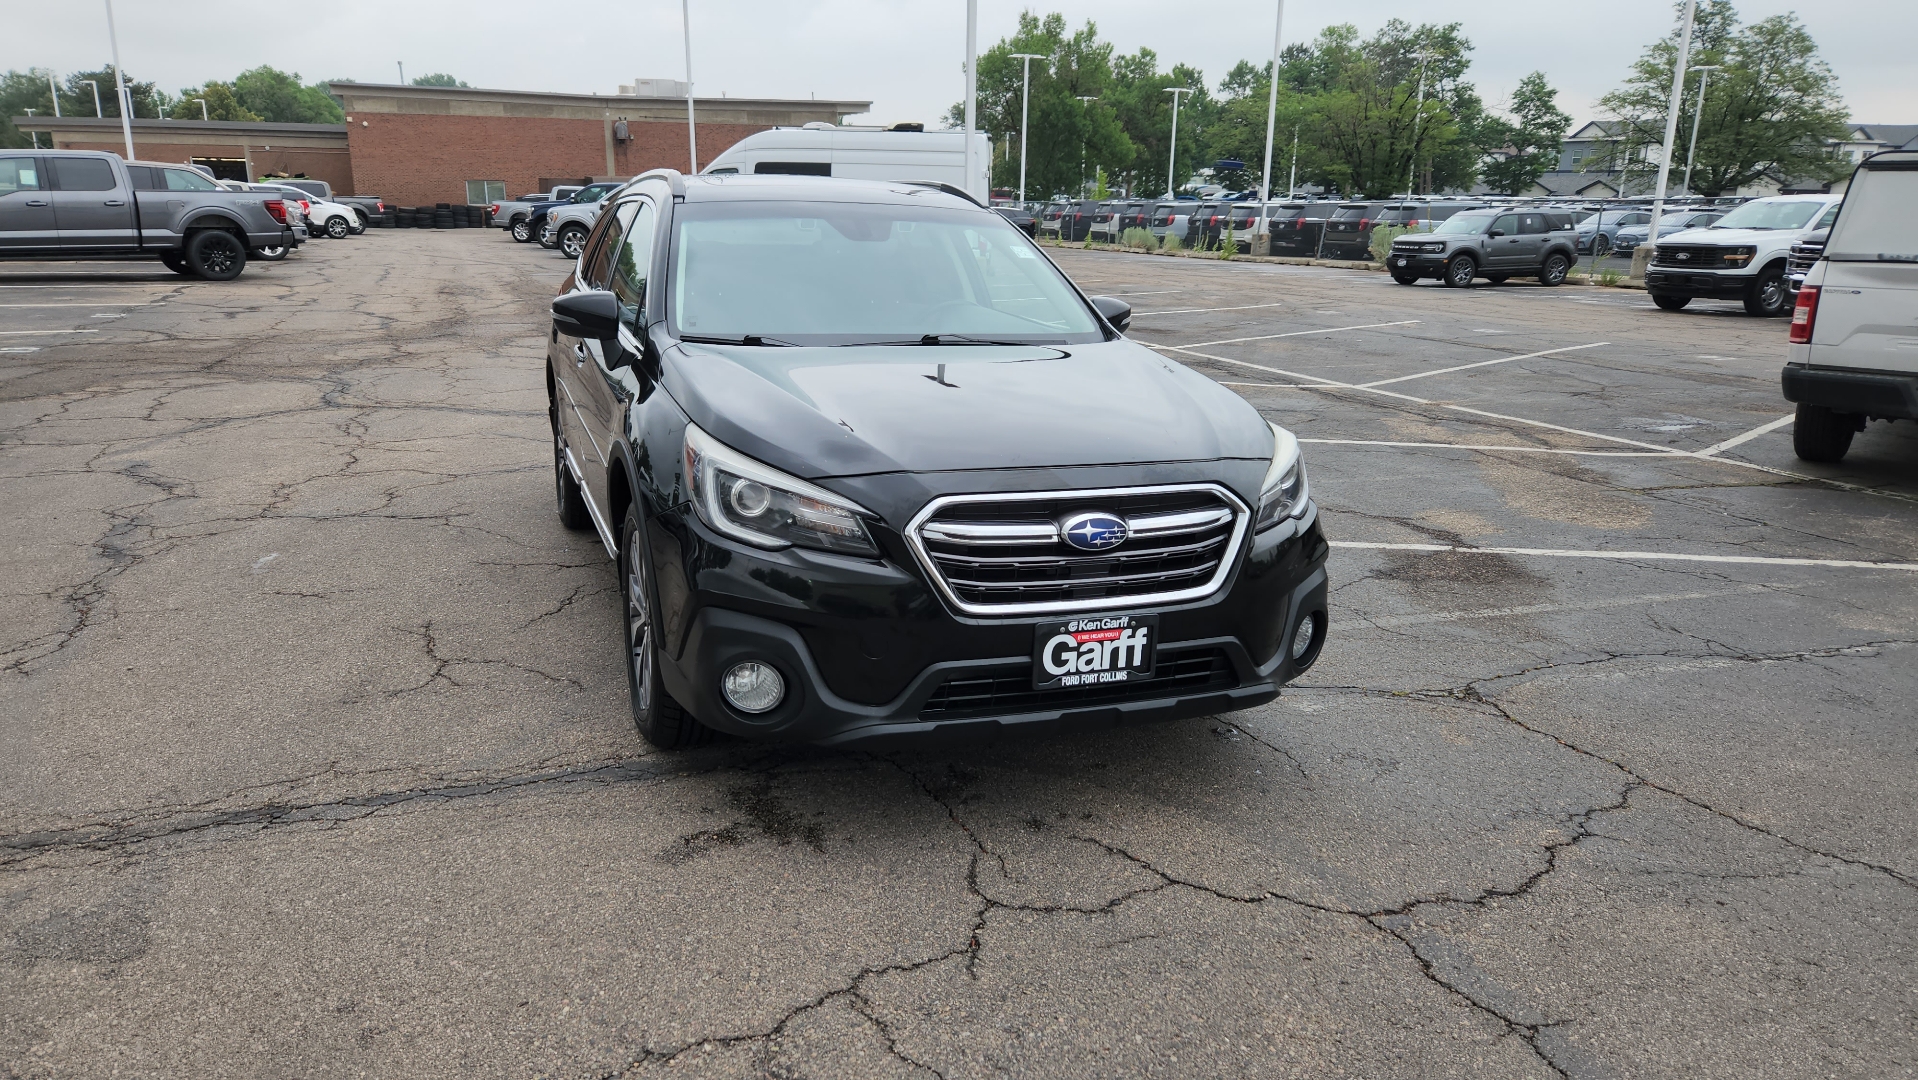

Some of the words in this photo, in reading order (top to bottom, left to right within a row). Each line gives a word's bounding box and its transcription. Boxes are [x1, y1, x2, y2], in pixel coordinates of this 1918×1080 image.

[1079, 619, 1101, 631] Ken
[1101, 616, 1129, 630] Garff
[1090, 632, 1104, 640] HEAR
[1042, 627, 1148, 676] Garff
[1061, 675, 1080, 686] FORD
[1080, 673, 1099, 685] FORT
[1099, 671, 1128, 682] COLLINS
